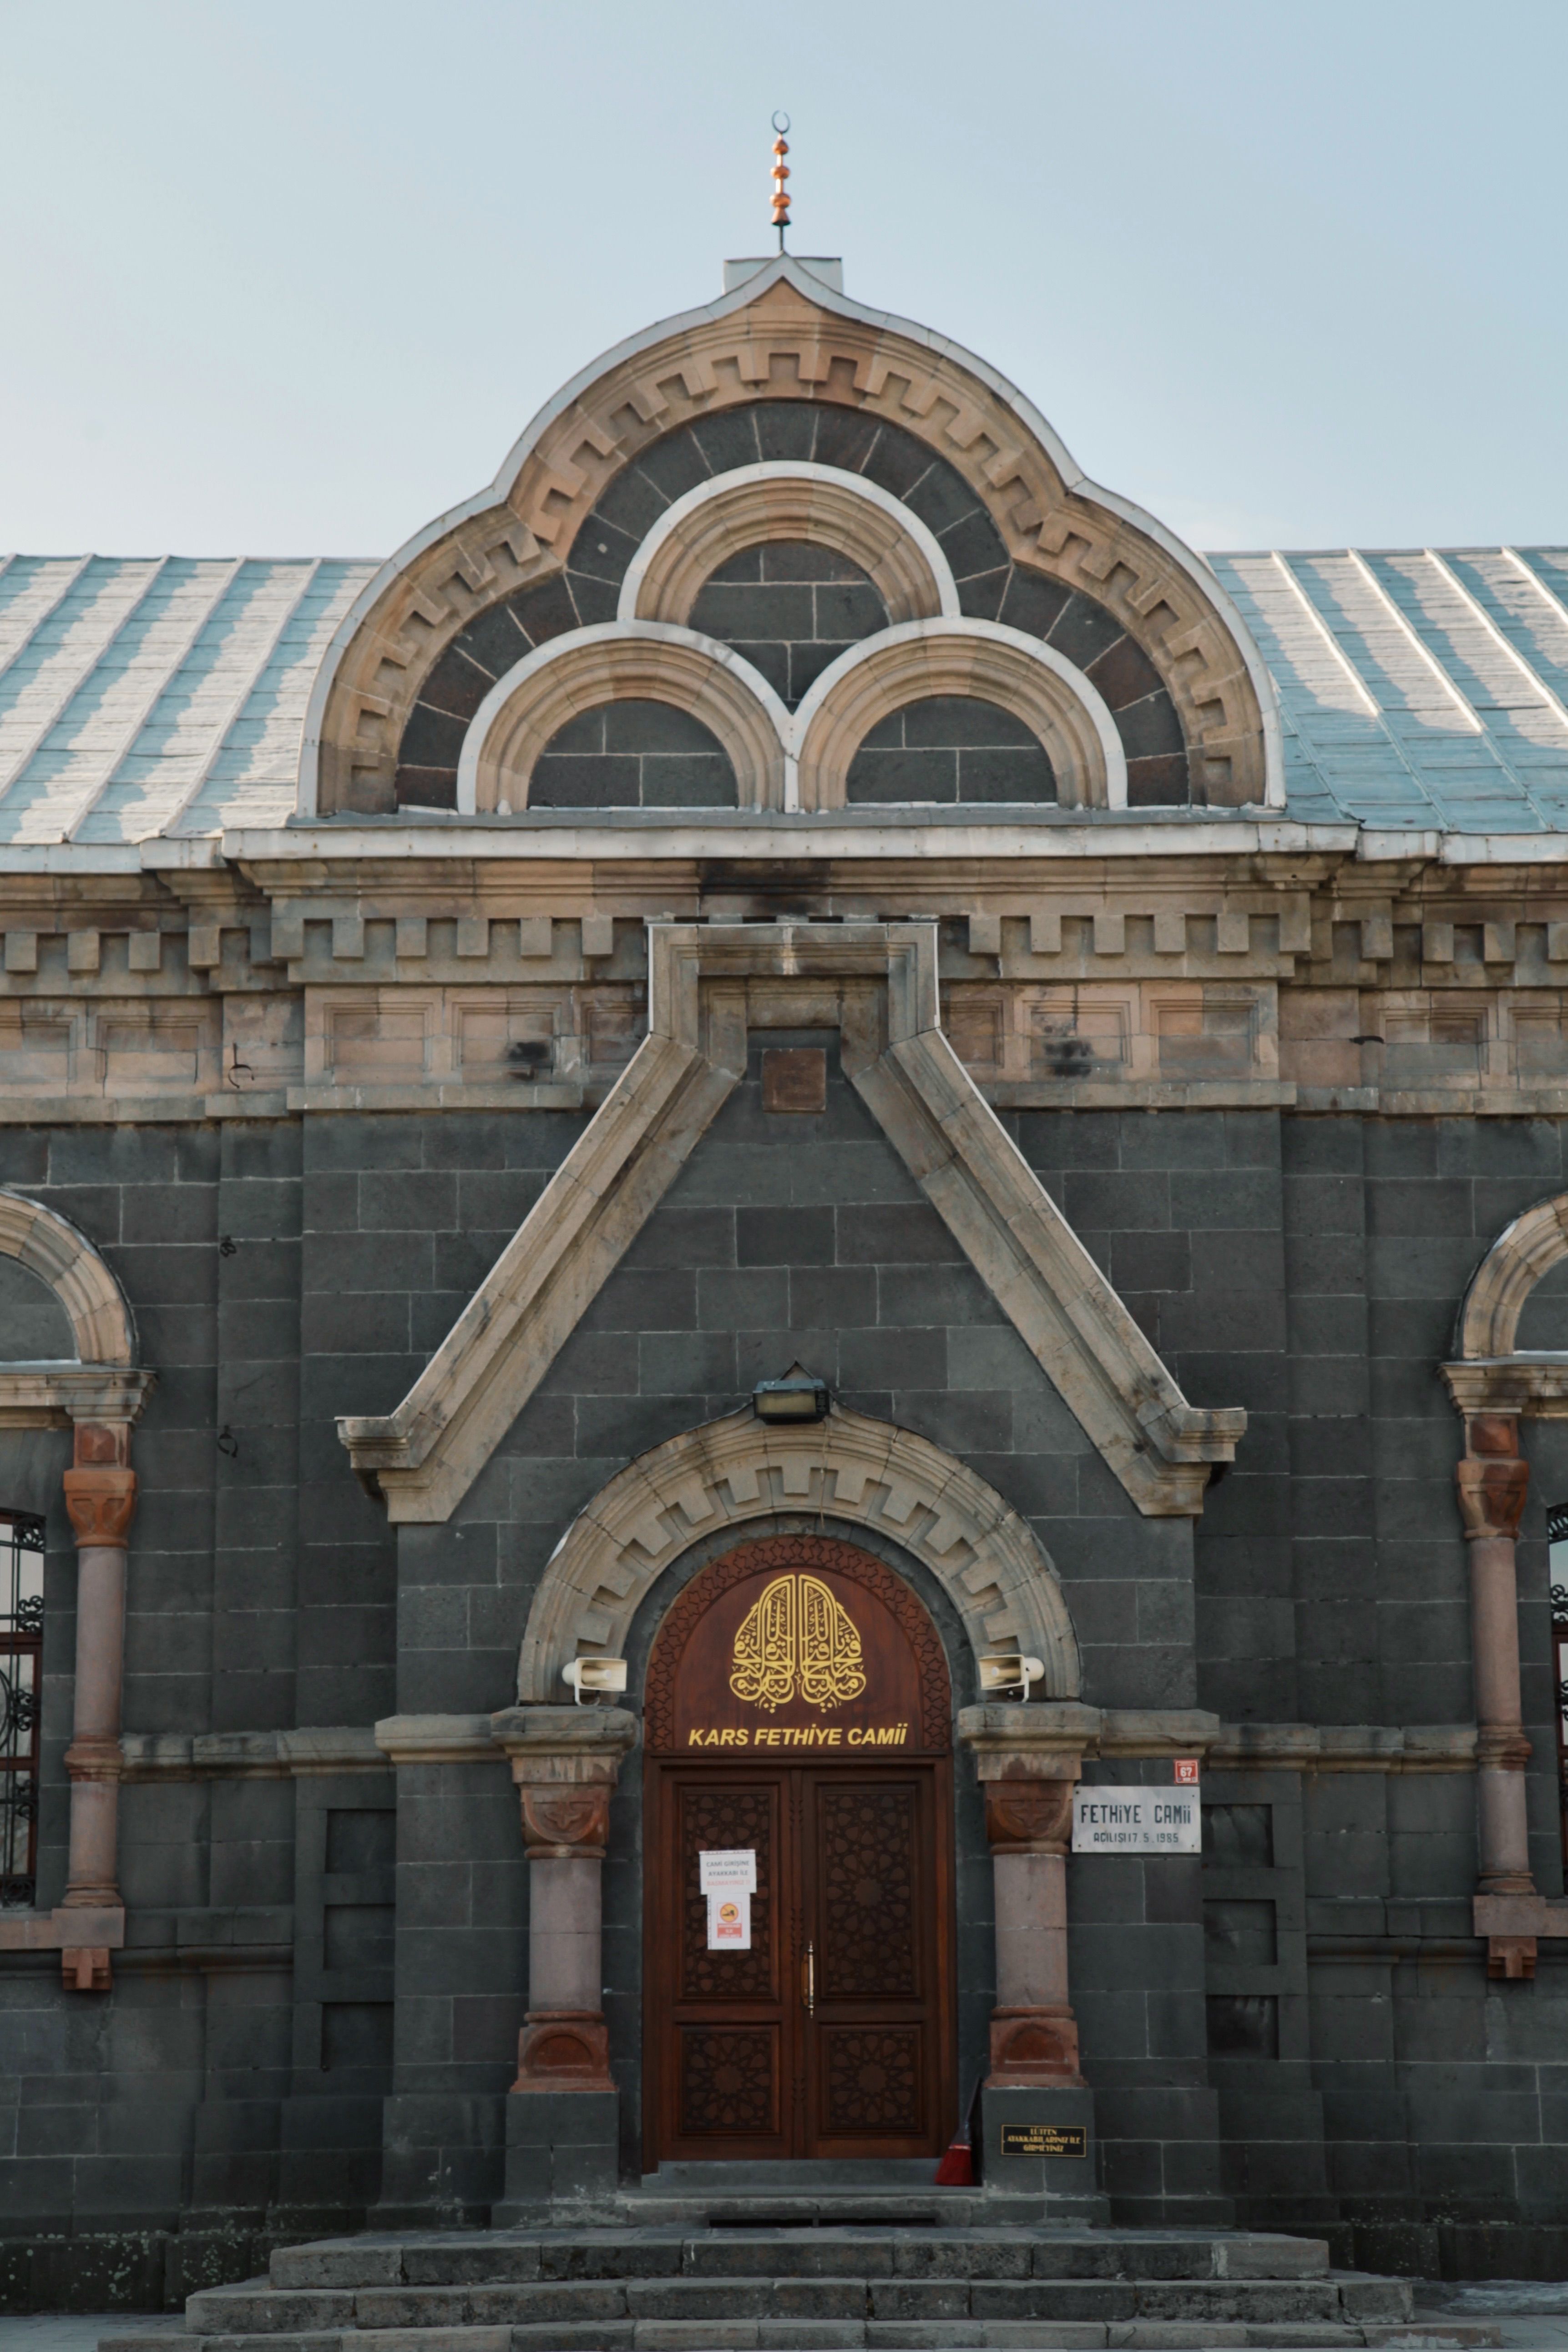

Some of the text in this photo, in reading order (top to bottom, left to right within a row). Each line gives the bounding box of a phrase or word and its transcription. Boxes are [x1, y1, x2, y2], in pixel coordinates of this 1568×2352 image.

[688, 1723, 908, 1745] KARS FETHİYE CAMİİ
[1179, 1766, 1193, 1777] 67
[1081, 1805, 1191, 1824] FETHİYE CAMİİ
